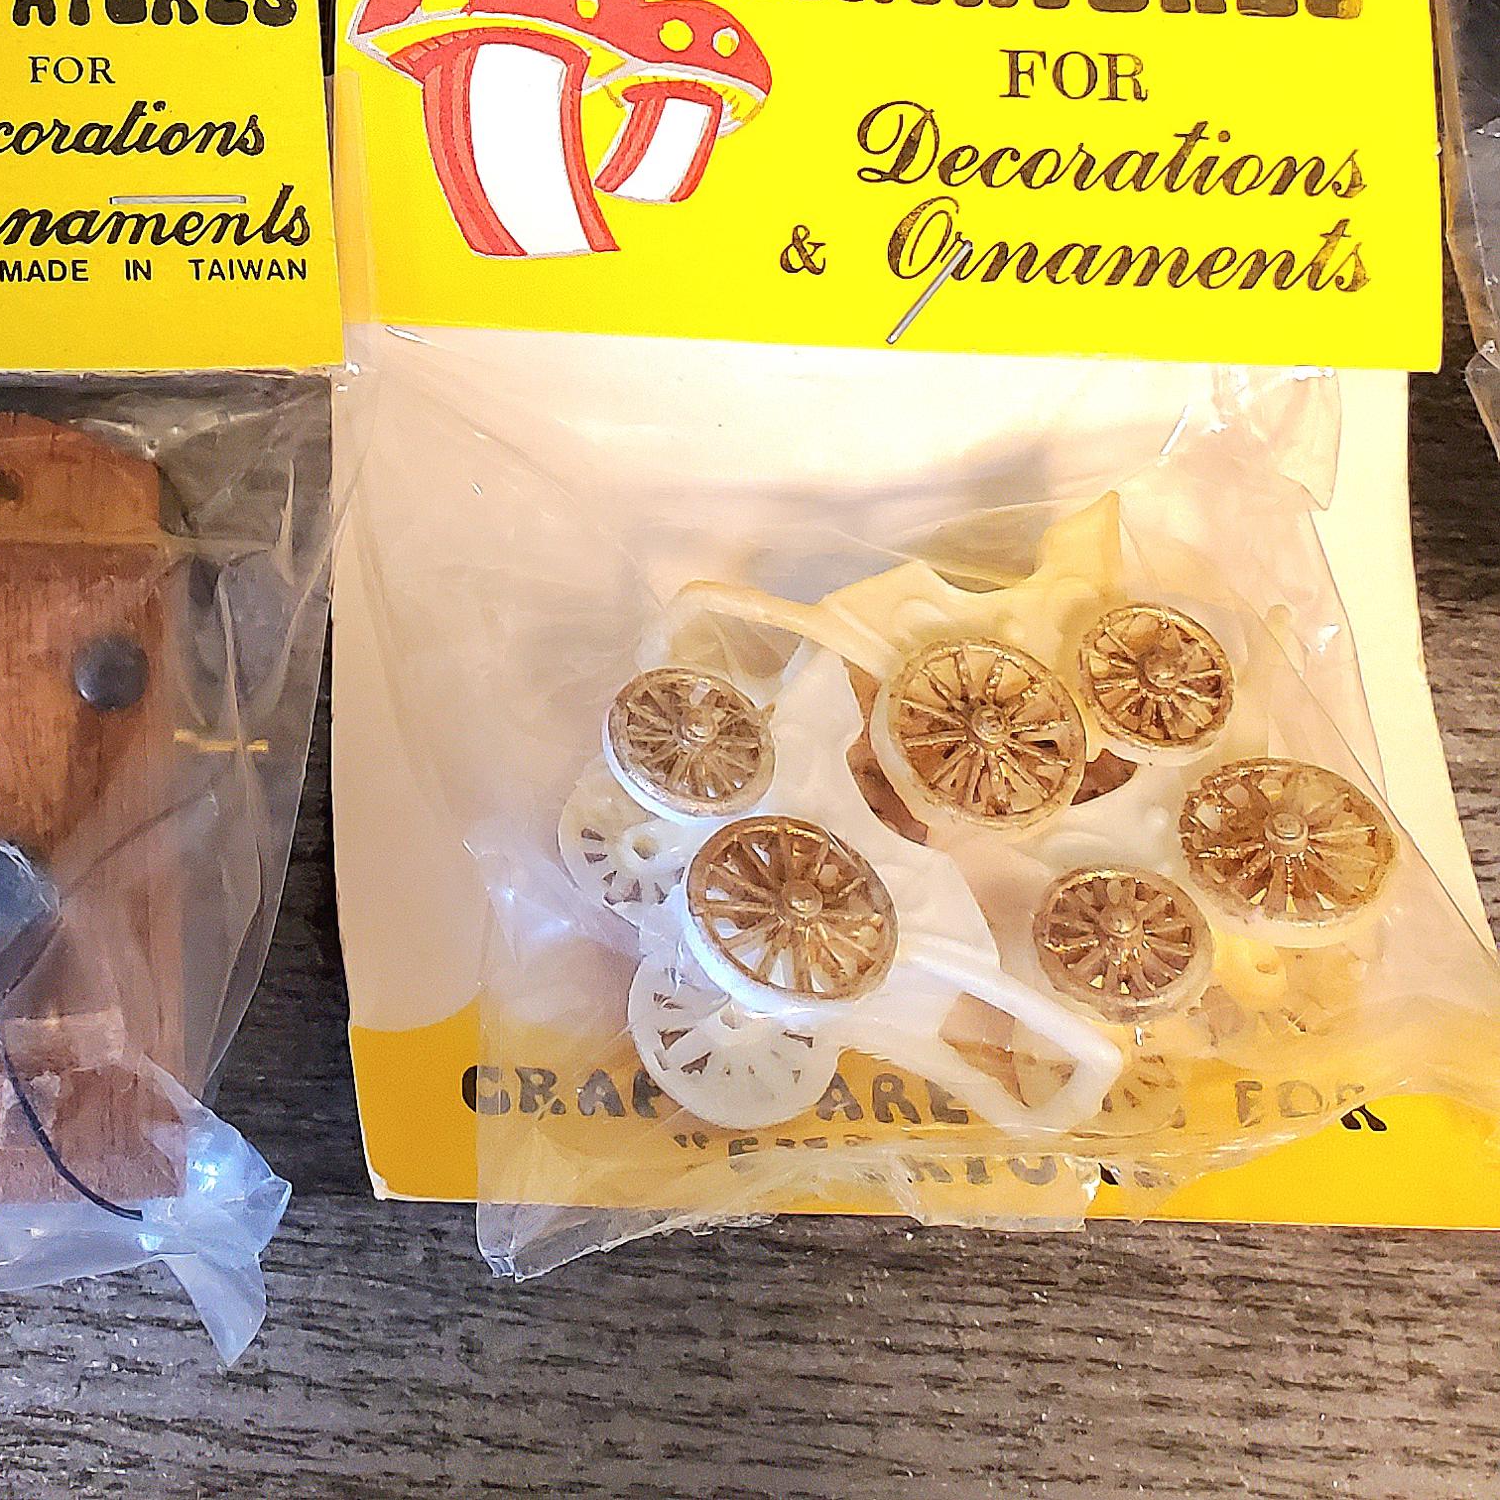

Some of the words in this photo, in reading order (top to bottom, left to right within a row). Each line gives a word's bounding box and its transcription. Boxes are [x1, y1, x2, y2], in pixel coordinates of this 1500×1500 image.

[28, 55, 116, 84] FOR
[999, 49, 1149, 103] FOR
[856, 100, 1368, 200] Decorations
[0, 259, 89, 283] MADE
[124, 258, 152, 282] IN
[187, 258, 307, 282] TAIWAN
[779, 224, 827, 276] &
[887, 196, 1371, 294] Ornaments
